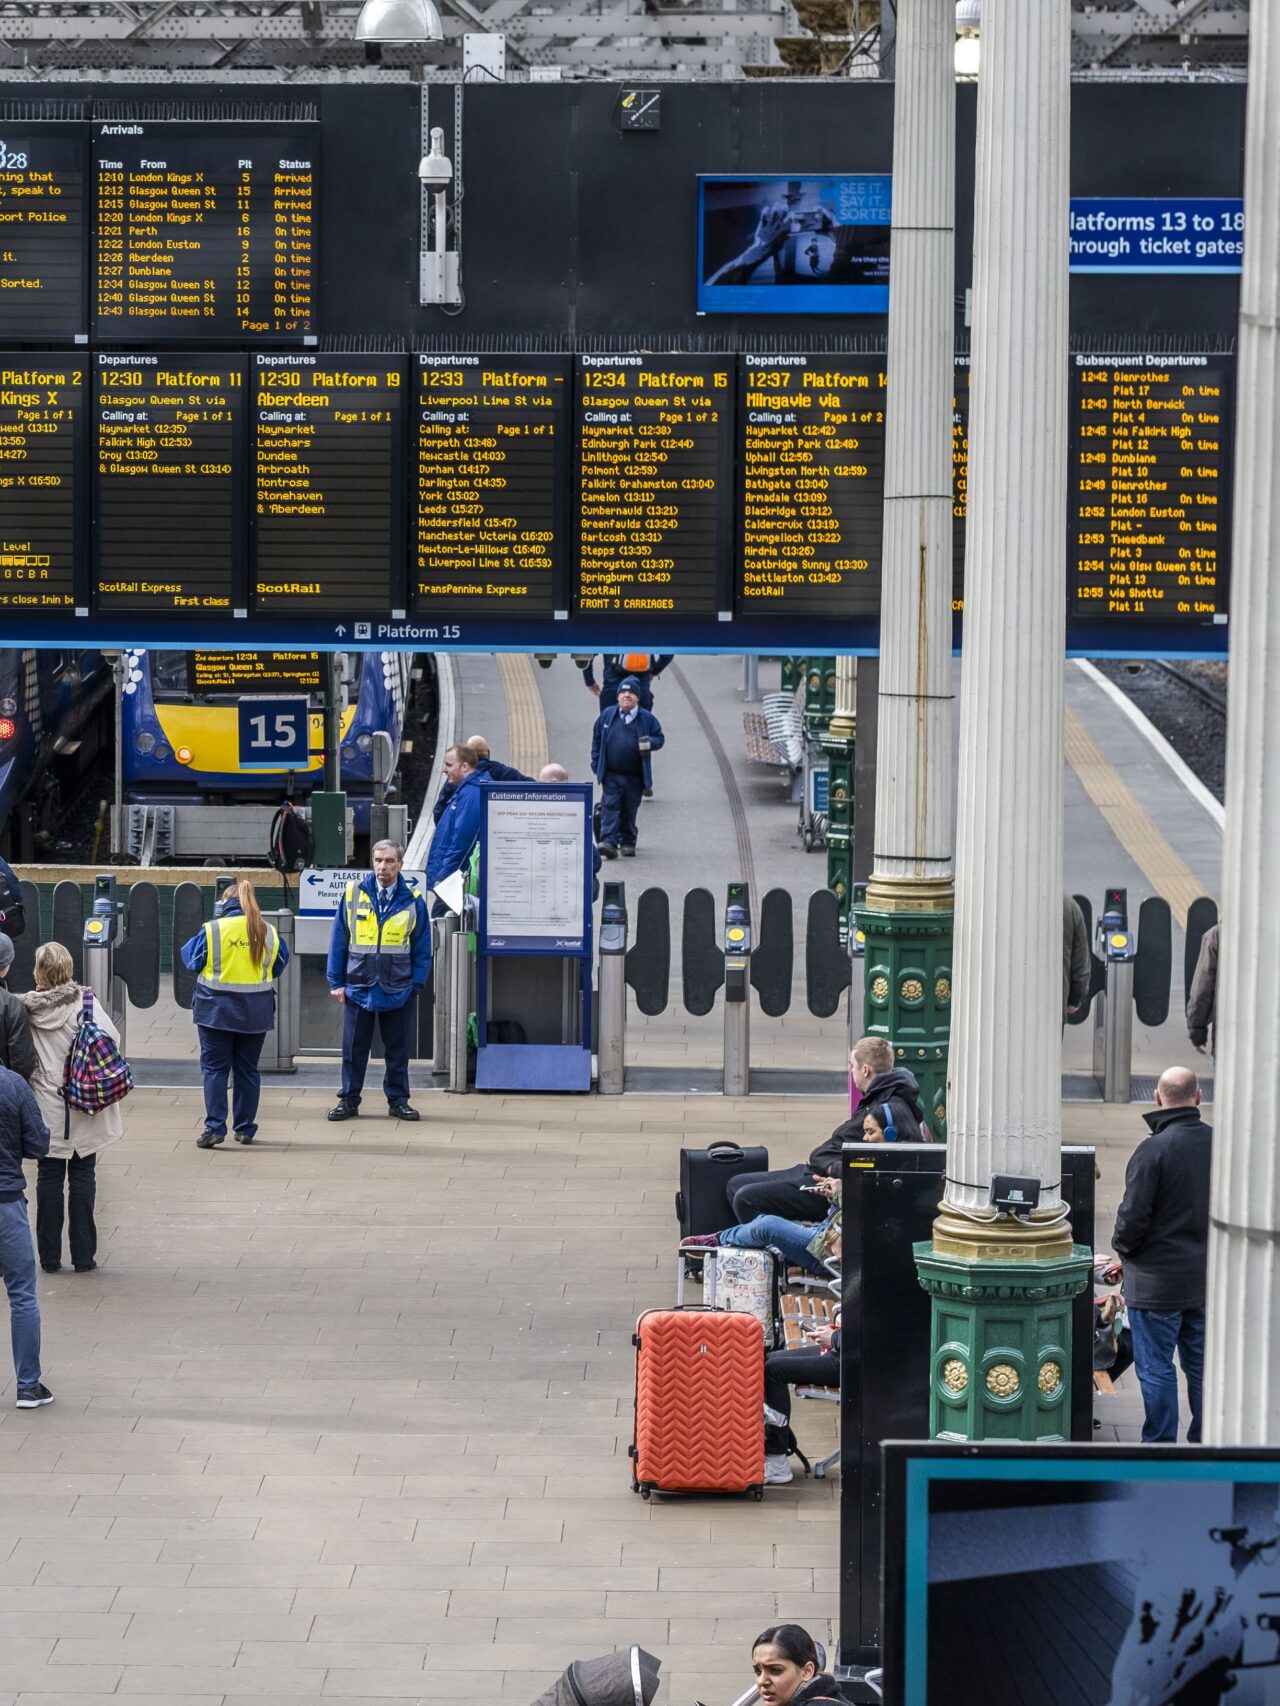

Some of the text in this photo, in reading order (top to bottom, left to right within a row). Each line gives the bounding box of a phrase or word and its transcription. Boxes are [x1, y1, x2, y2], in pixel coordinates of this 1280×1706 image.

[101, 125, 143, 134] Arrivals
[99, 160, 311, 168] Time From Plt Status
[29, 172, 53, 181] that
[99, 173, 312, 184] 12:10 London Kings X 5 Arrived
[11, 186, 43, 196] speak
[49, 186, 61, 194] to
[29, 212, 66, 221] Police
[1162, 212, 1245, 231] 13 to 18
[1140, 237, 1244, 257] ticket gates
[3, 252, 16, 261] it.
[1, 279, 43, 288] Sorted.
[1076, 355, 1207, 368] Subsequent Departures
[3, 371, 65, 384] Platform
[73, 372, 80, 385] 2
[1081, 372, 1170, 382] 12:42 Glenrothes
[2, 391, 40, 406] Kings
[48, 392, 57, 404] X
[257, 392, 329, 407] Aberdeen
[258, 491, 322, 500] Stonehaven
[4, 542, 30, 551] Level
[378, 625, 460, 638] Platform 15
[250, 715, 296, 747] 15
[491, 792, 567, 801] Customer Information
[333, 872, 362, 881] PLEASE
[317, 890, 339, 898] Please
